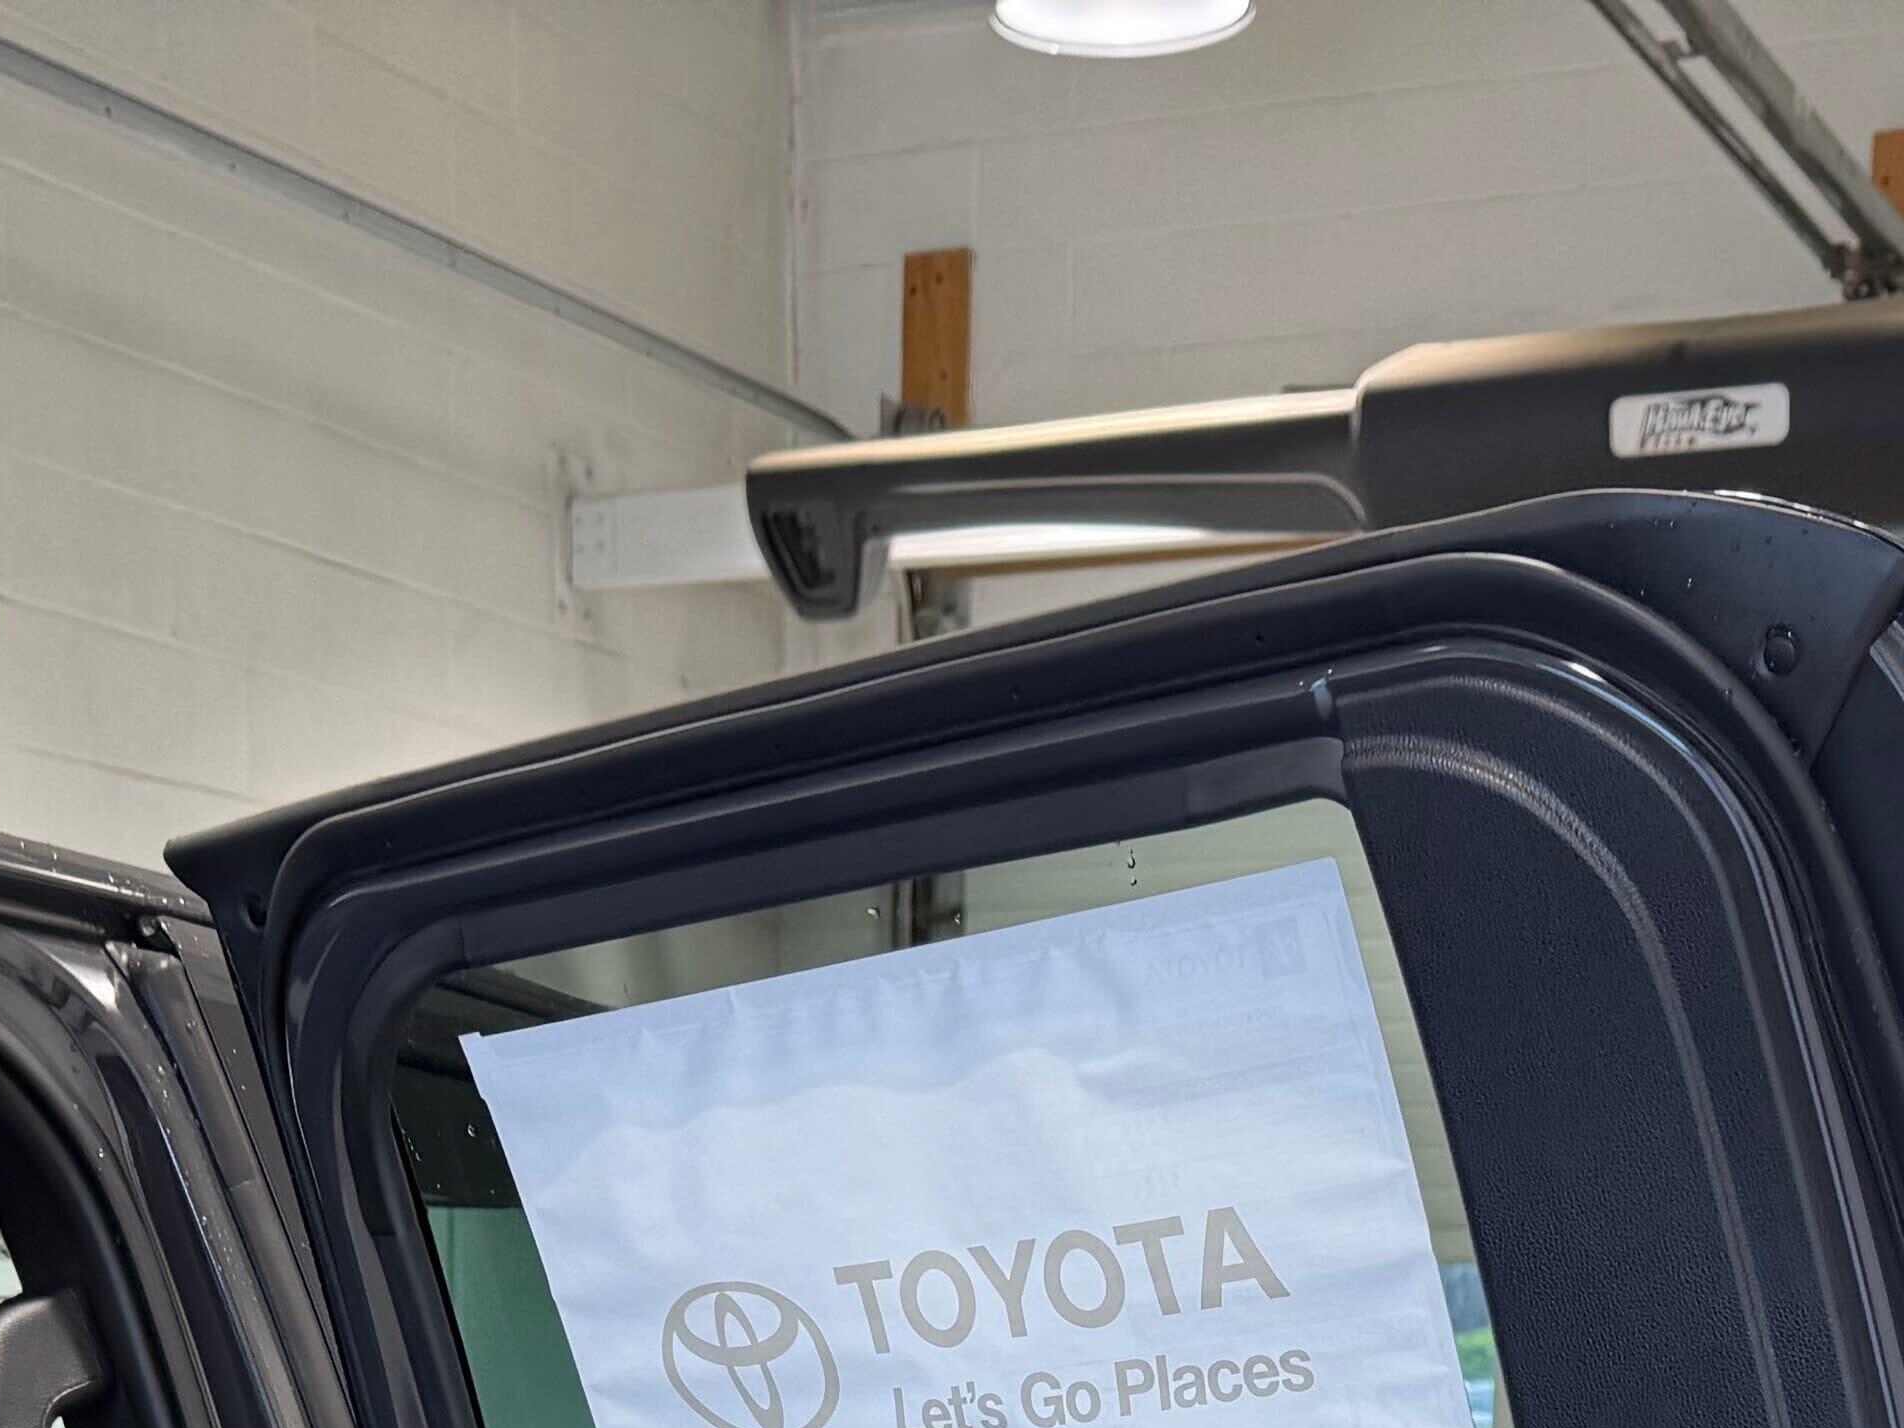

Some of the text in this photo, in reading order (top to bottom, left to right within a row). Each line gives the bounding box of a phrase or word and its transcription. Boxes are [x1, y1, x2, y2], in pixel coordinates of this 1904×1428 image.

[834, 1206, 1290, 1356] TOYOTA
[1019, 1371, 1099, 1428] Go
[1114, 1349, 1316, 1417] Places
